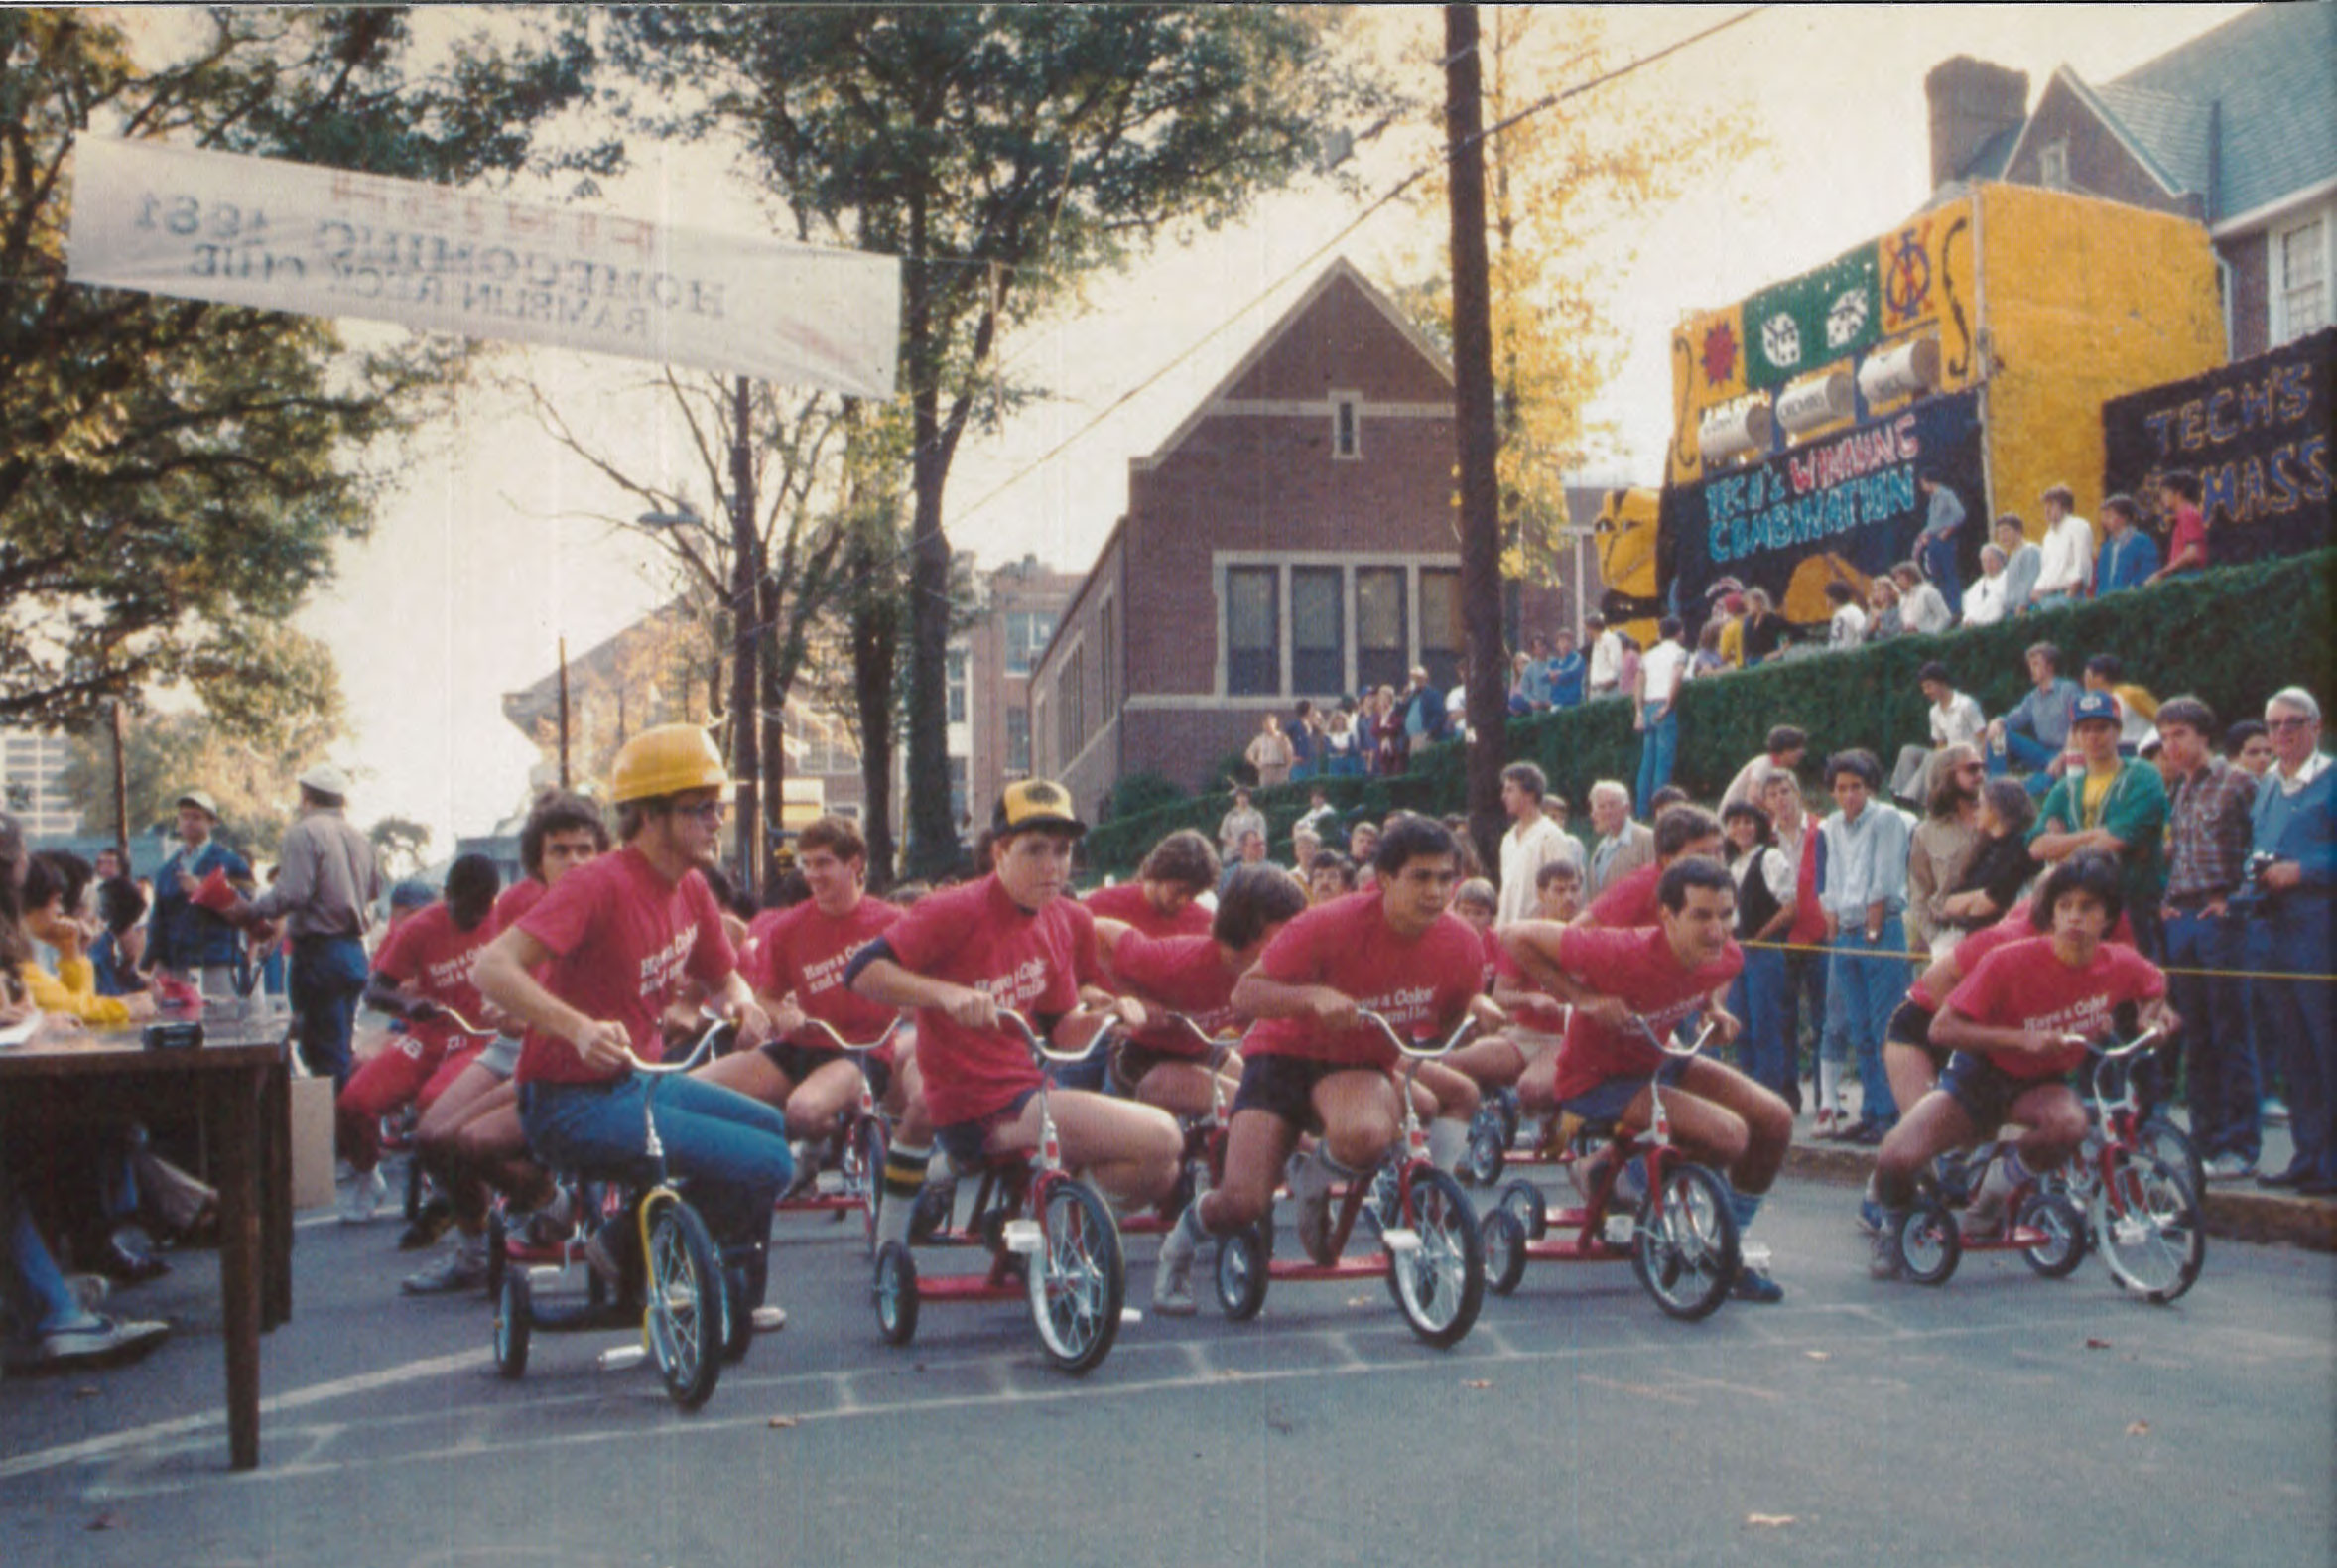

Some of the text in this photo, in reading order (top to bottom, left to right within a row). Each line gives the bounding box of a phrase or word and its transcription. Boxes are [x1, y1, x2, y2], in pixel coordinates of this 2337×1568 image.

[1789, 414, 1919, 494] WINNING
[2199, 435, 2332, 529] MASS
[1708, 463, 1915, 563] COMBINATION
